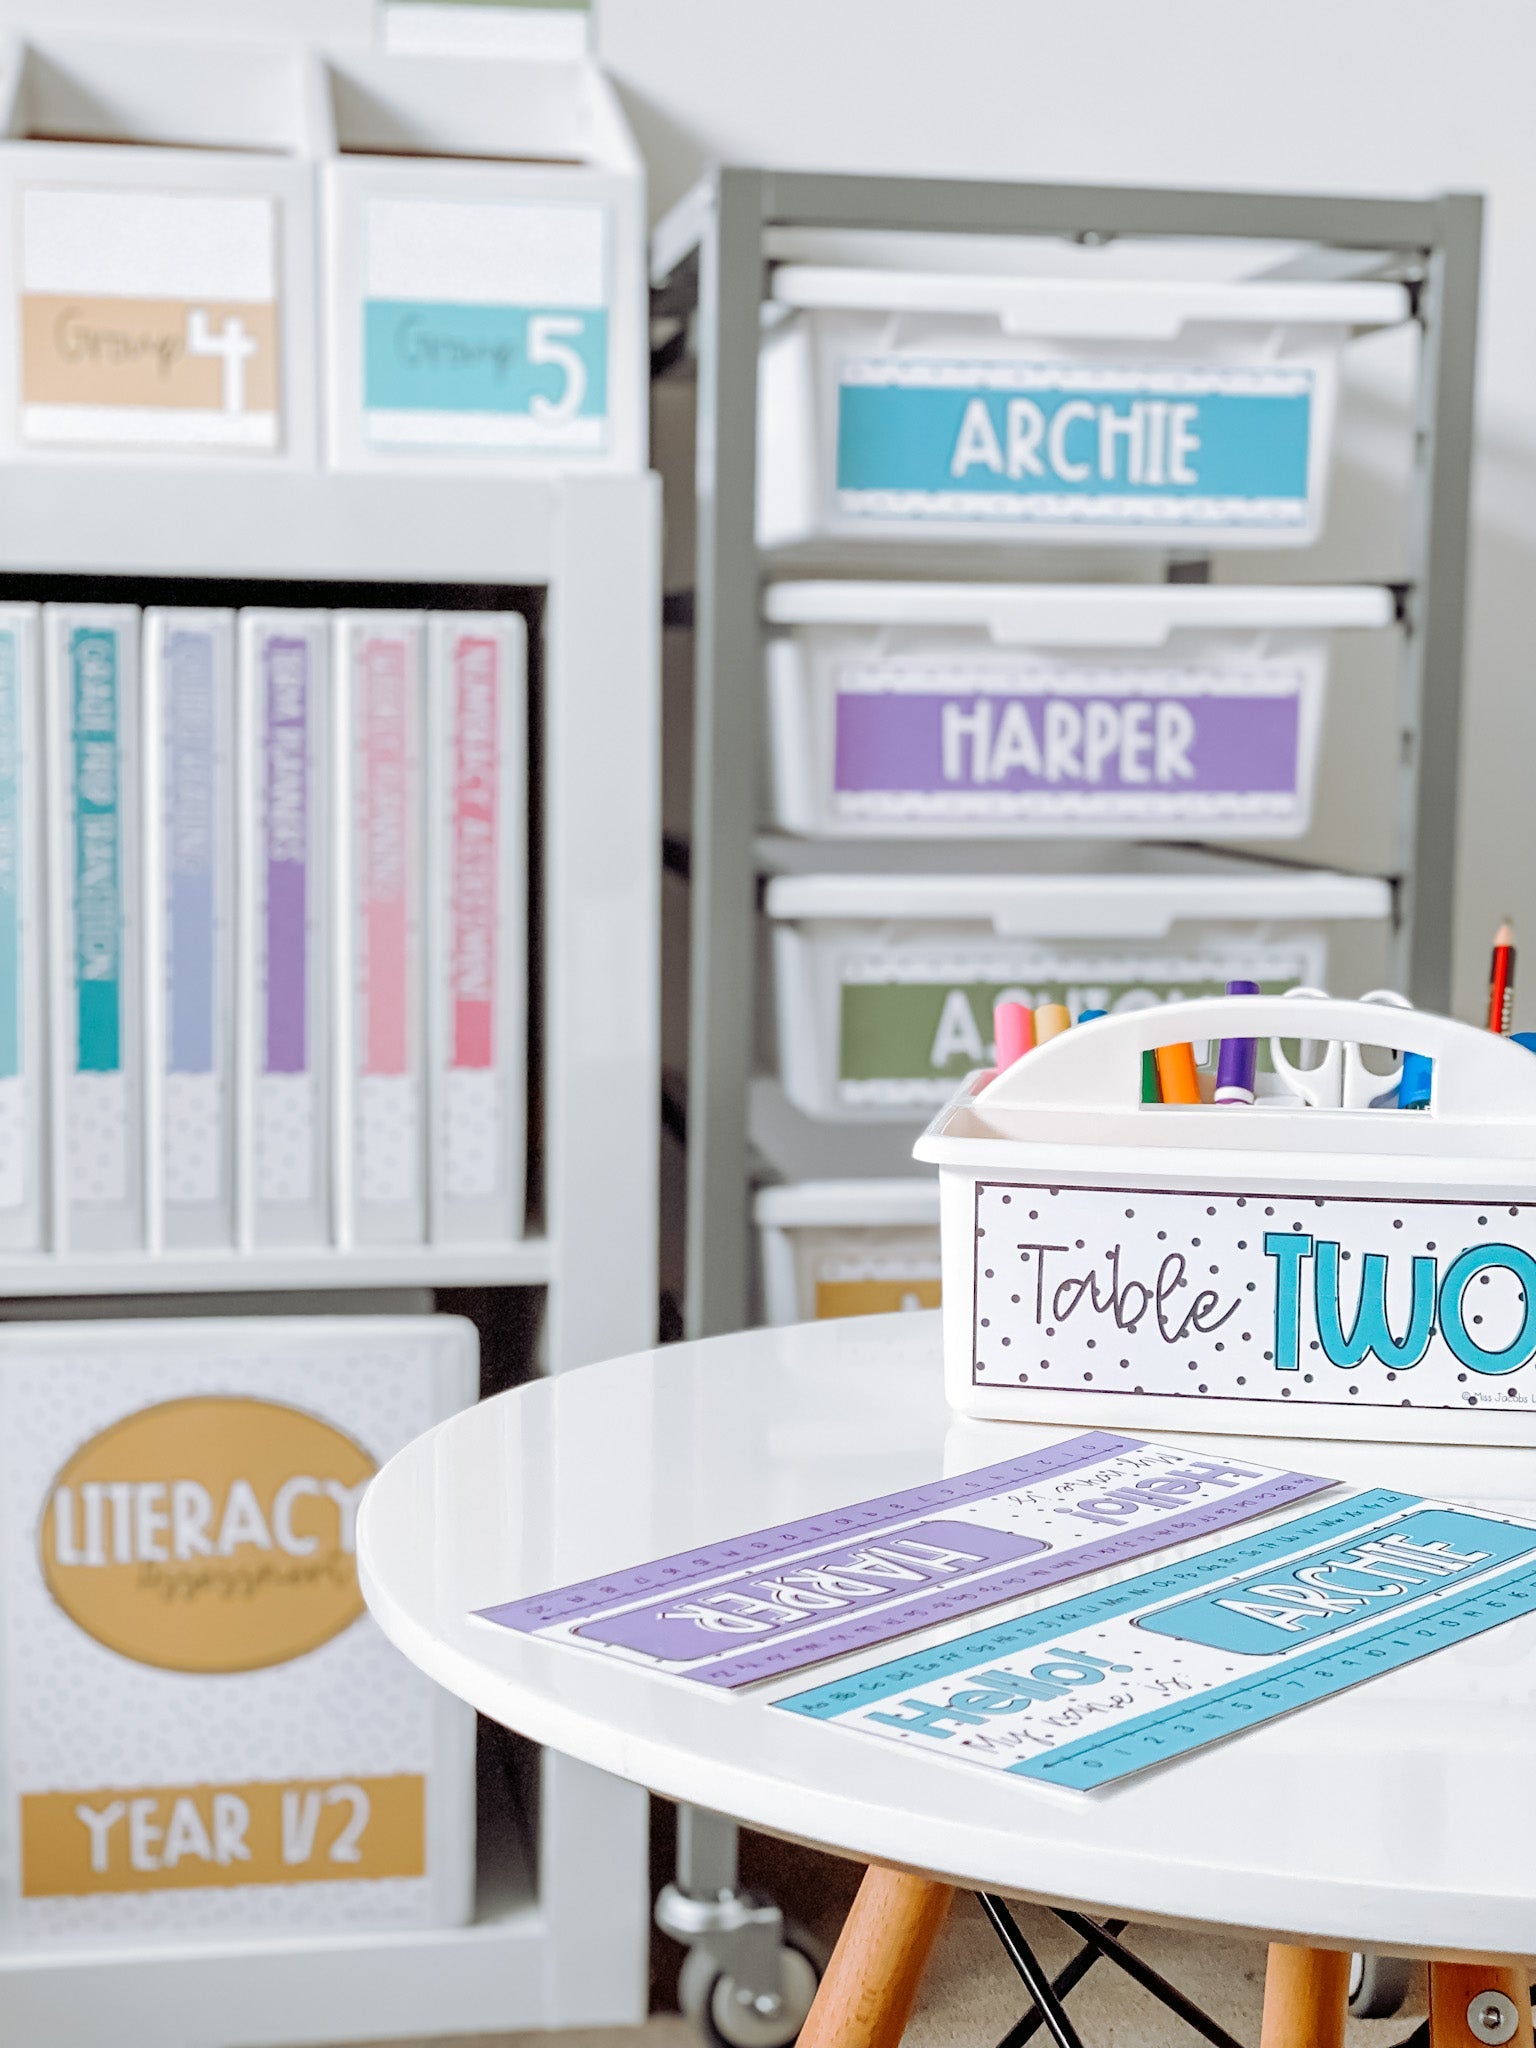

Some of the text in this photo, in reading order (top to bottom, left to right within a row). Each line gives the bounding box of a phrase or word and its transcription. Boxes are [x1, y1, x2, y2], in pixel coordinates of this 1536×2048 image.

[186, 308, 255, 419] 4
[526, 314, 585, 427] 5
[950, 397, 1202, 485] ARCHIE
[940, 699, 1198, 784] HARPER
[1016, 1231, 1536, 1376] Table TWO
[52, 1475, 372, 1568] LITERACY
[1053, 1460, 1265, 1528] Hello!
[656, 1538, 990, 1635] HARPER
[1210, 1532, 1500, 1634] ARCHIE
[862, 1645, 1134, 1740] Hello!
[967, 1730, 1055, 1754] My
[1041, 1692, 1134, 1727] name
[1083, 1760, 1103, 1768] 0
[1114, 1748, 1132, 1756] 1
[1143, 1736, 1165, 1745] 2
[1173, 1724, 1195, 1733] 3
[1231, 1702, 1252, 1710] 5
[1261, 1691, 1281, 1699] 6
[1286, 1680, 1305, 1688] 7
[1314, 1670, 1334, 1678] 8
[75, 1793, 252, 1873] YEAR
